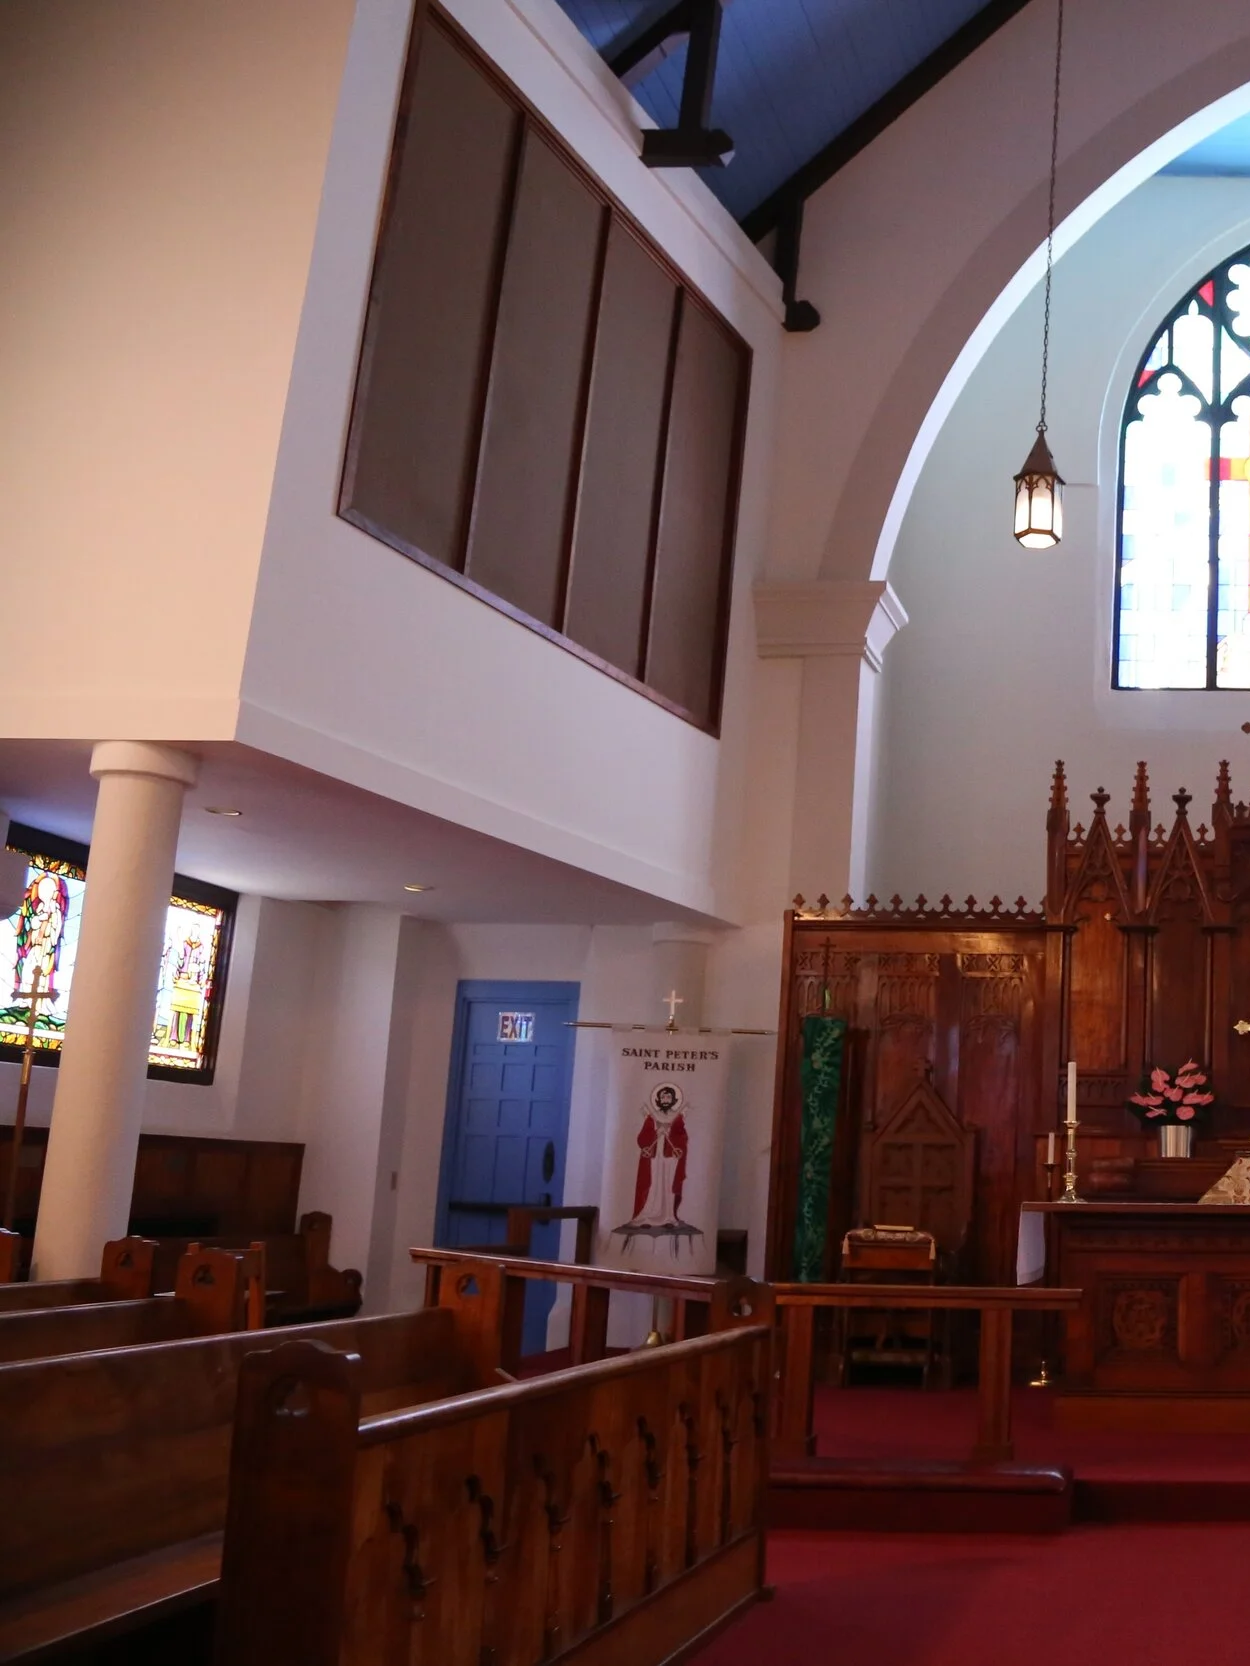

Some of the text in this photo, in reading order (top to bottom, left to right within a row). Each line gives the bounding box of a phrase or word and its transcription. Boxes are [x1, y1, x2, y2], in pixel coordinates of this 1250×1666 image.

[500, 1015, 533, 1039] EXIT
[621, 1047, 720, 1060] SAINT PETER'S
[644, 1061, 696, 1072] PARISH
